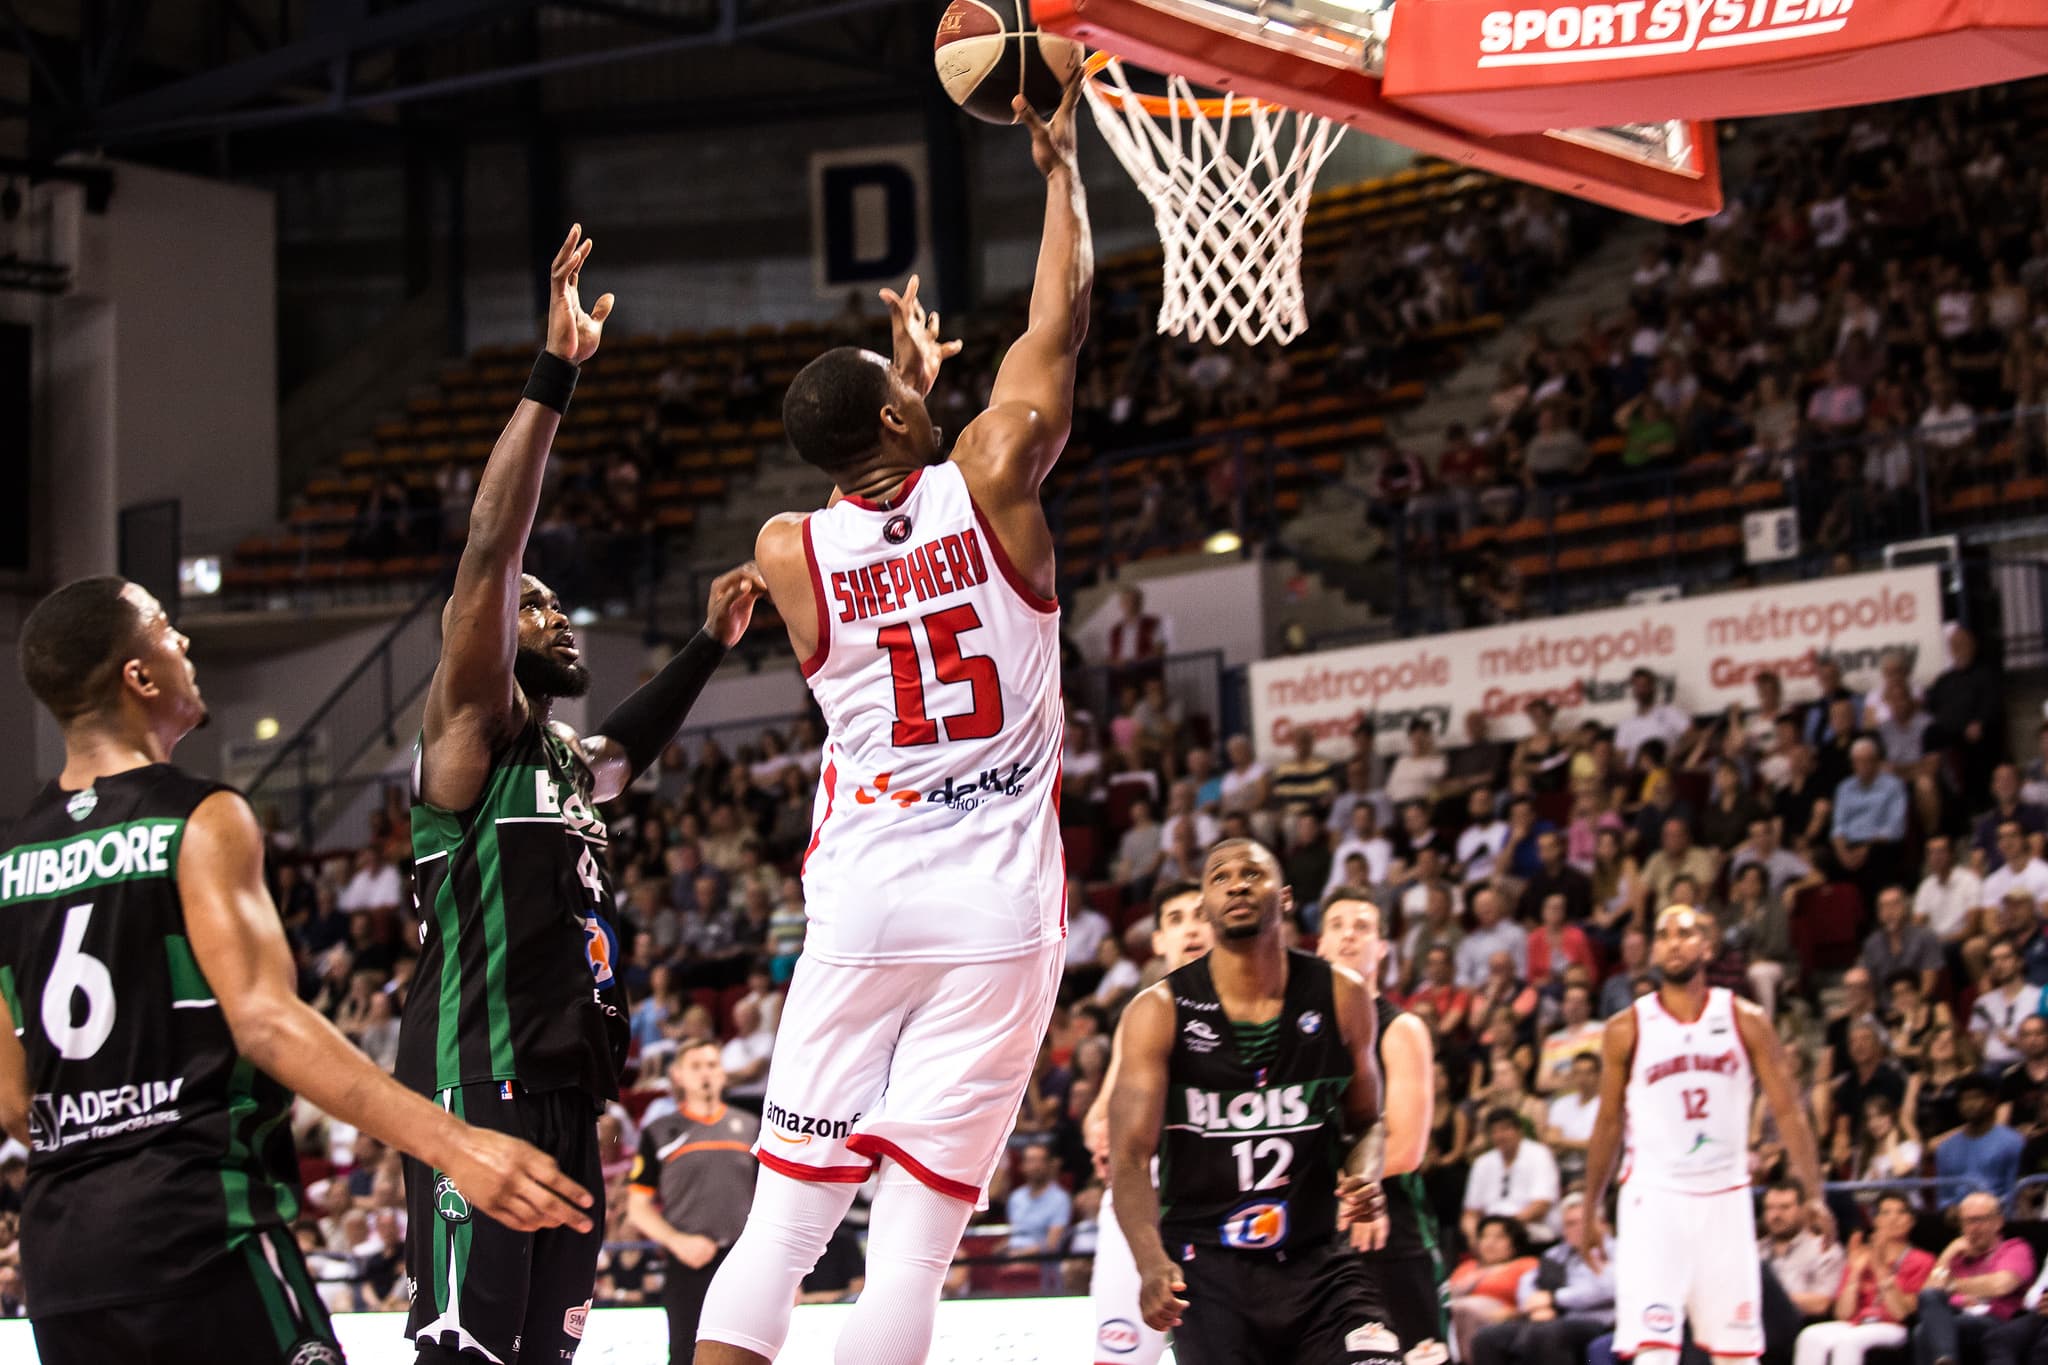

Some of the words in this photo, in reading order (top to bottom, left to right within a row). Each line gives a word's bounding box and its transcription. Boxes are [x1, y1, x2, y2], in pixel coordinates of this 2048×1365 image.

[822, 162, 916, 285] D
[831, 528, 988, 623] SHEPHERD
[1707, 583, 1917, 645] métropole
[877, 602, 1004, 747] 15
[1267, 650, 1449, 709] métropole
[1479, 618, 1676, 680] métropole
[576, 844, 604, 903] 4
[41, 903, 116, 1060] 6
[1185, 1084, 1309, 1131] BLOIS
[1681, 1088, 1709, 1121] 12
[1232, 1136, 1294, 1192] 12
